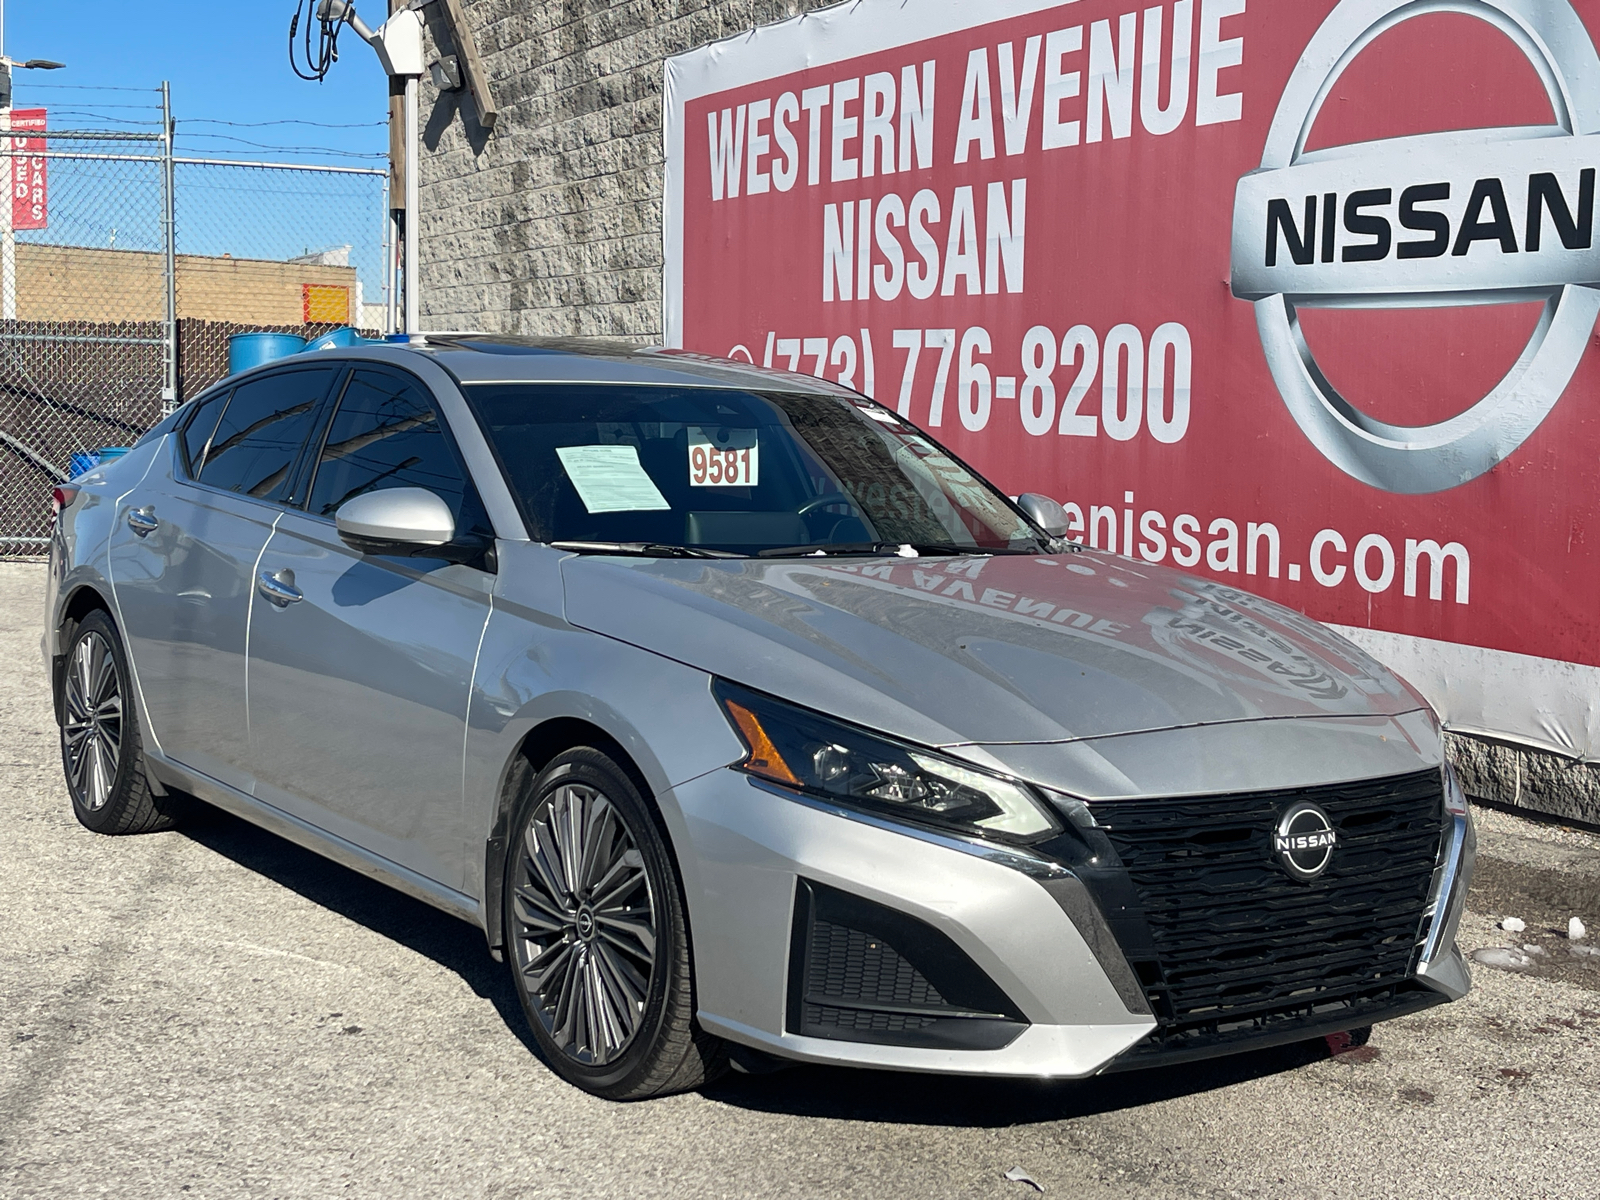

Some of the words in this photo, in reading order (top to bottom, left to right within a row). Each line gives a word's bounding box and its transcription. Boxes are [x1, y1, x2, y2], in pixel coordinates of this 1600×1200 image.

[11, 119, 46, 128] CERTIFIED
[707, 59, 936, 202] WESTERN
[953, 0, 1246, 166] AVENUE
[31, 155, 43, 220] CARS
[1265, 167, 1597, 268] NISSAN
[822, 178, 1027, 303] NISSAN
[893, 321, 1193, 445] 776-8200
[692, 446, 750, 484] 9581
[1062, 490, 1471, 605] enissan.com
[1276, 831, 1336, 850] NISSAN
